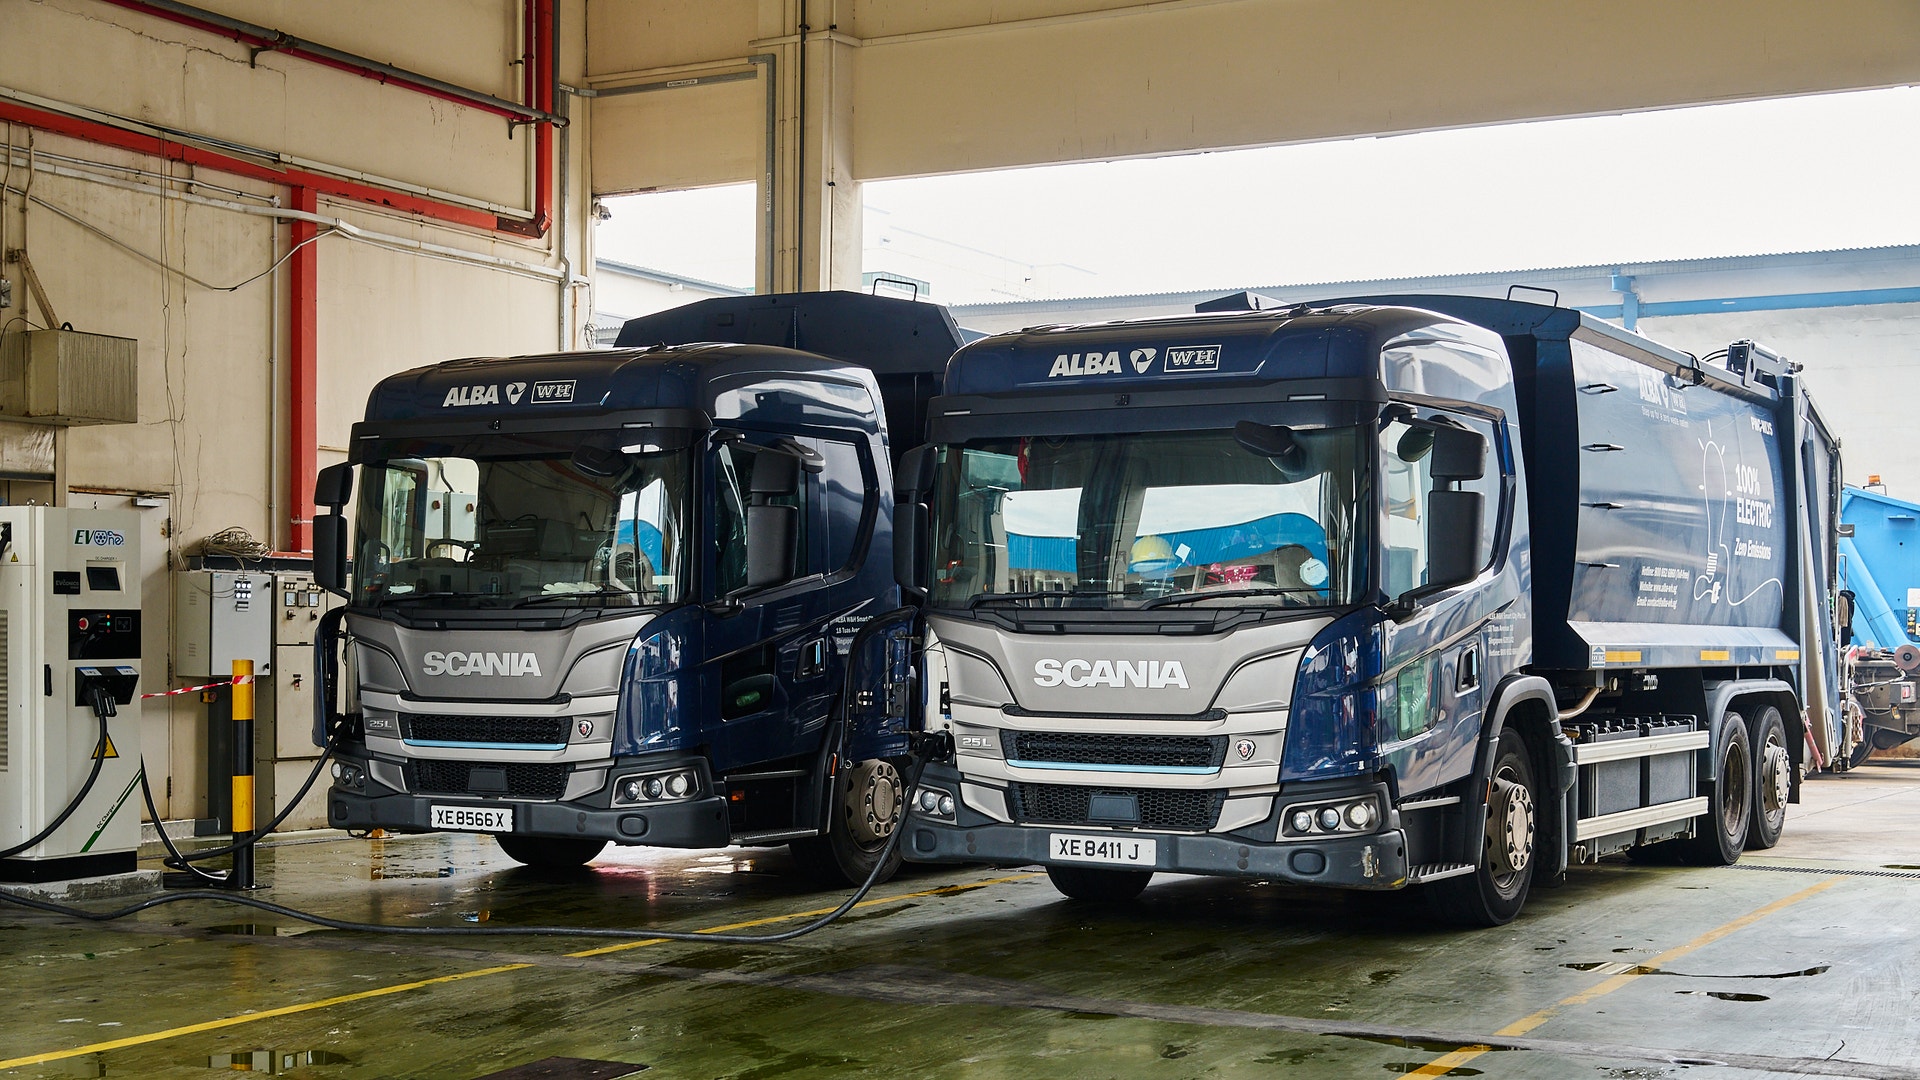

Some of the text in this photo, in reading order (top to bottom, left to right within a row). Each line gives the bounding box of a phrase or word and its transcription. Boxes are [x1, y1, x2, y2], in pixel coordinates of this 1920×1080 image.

[1048, 351, 1122, 378] ALBA
[442, 384, 500, 407] ALBA
[1639, 378, 1662, 406] ALBA
[1735, 463, 1760, 496] 100%
[1736, 497, 1772, 529] ELECTRIC
[1734, 537, 1772, 560] Zero Emissions
[423, 651, 542, 677] SCANIA
[1034, 658, 1190, 689] SCANIA
